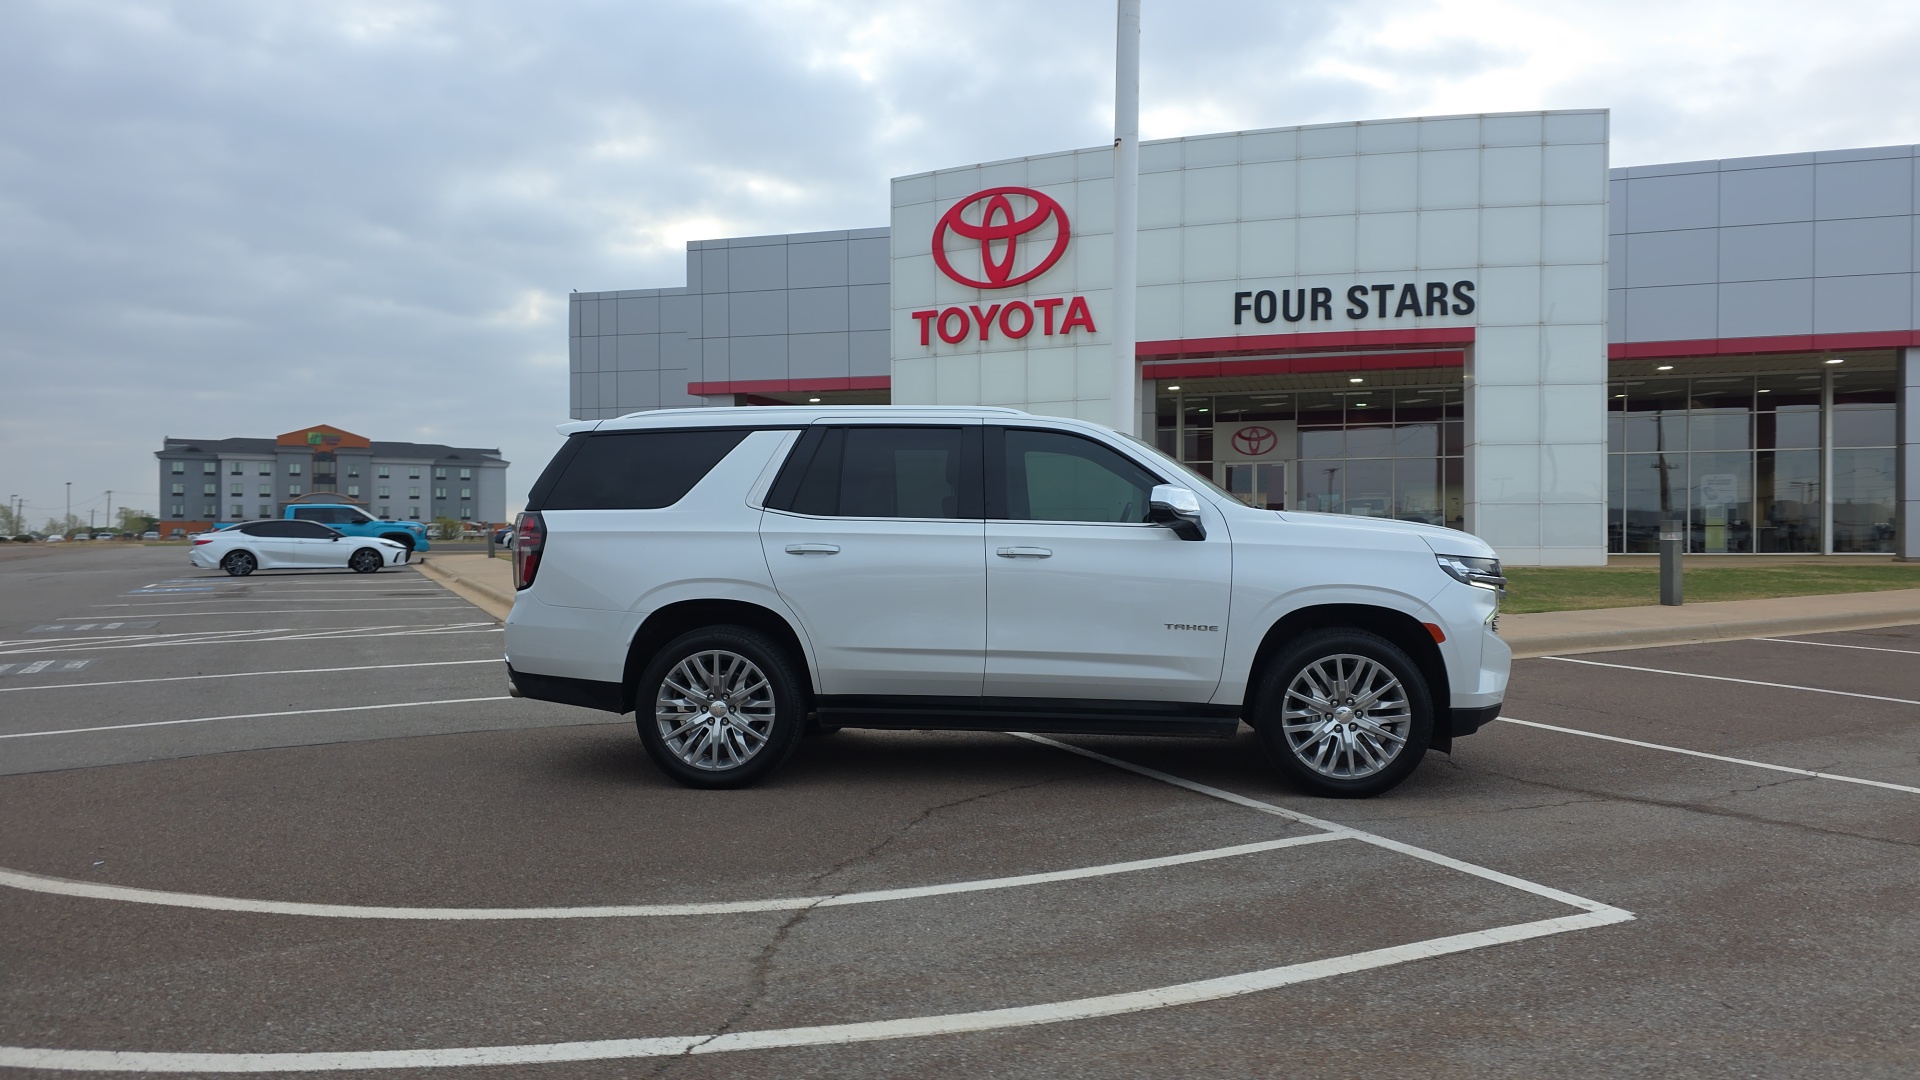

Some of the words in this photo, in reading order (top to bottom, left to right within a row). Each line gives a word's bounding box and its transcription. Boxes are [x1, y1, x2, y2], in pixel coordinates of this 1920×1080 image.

[911, 296, 1096, 346] TOYOTA
[1234, 287, 1332, 326] FOUR
[1346, 280, 1476, 320] STARS
[1163, 623, 1219, 632] TAHOE
